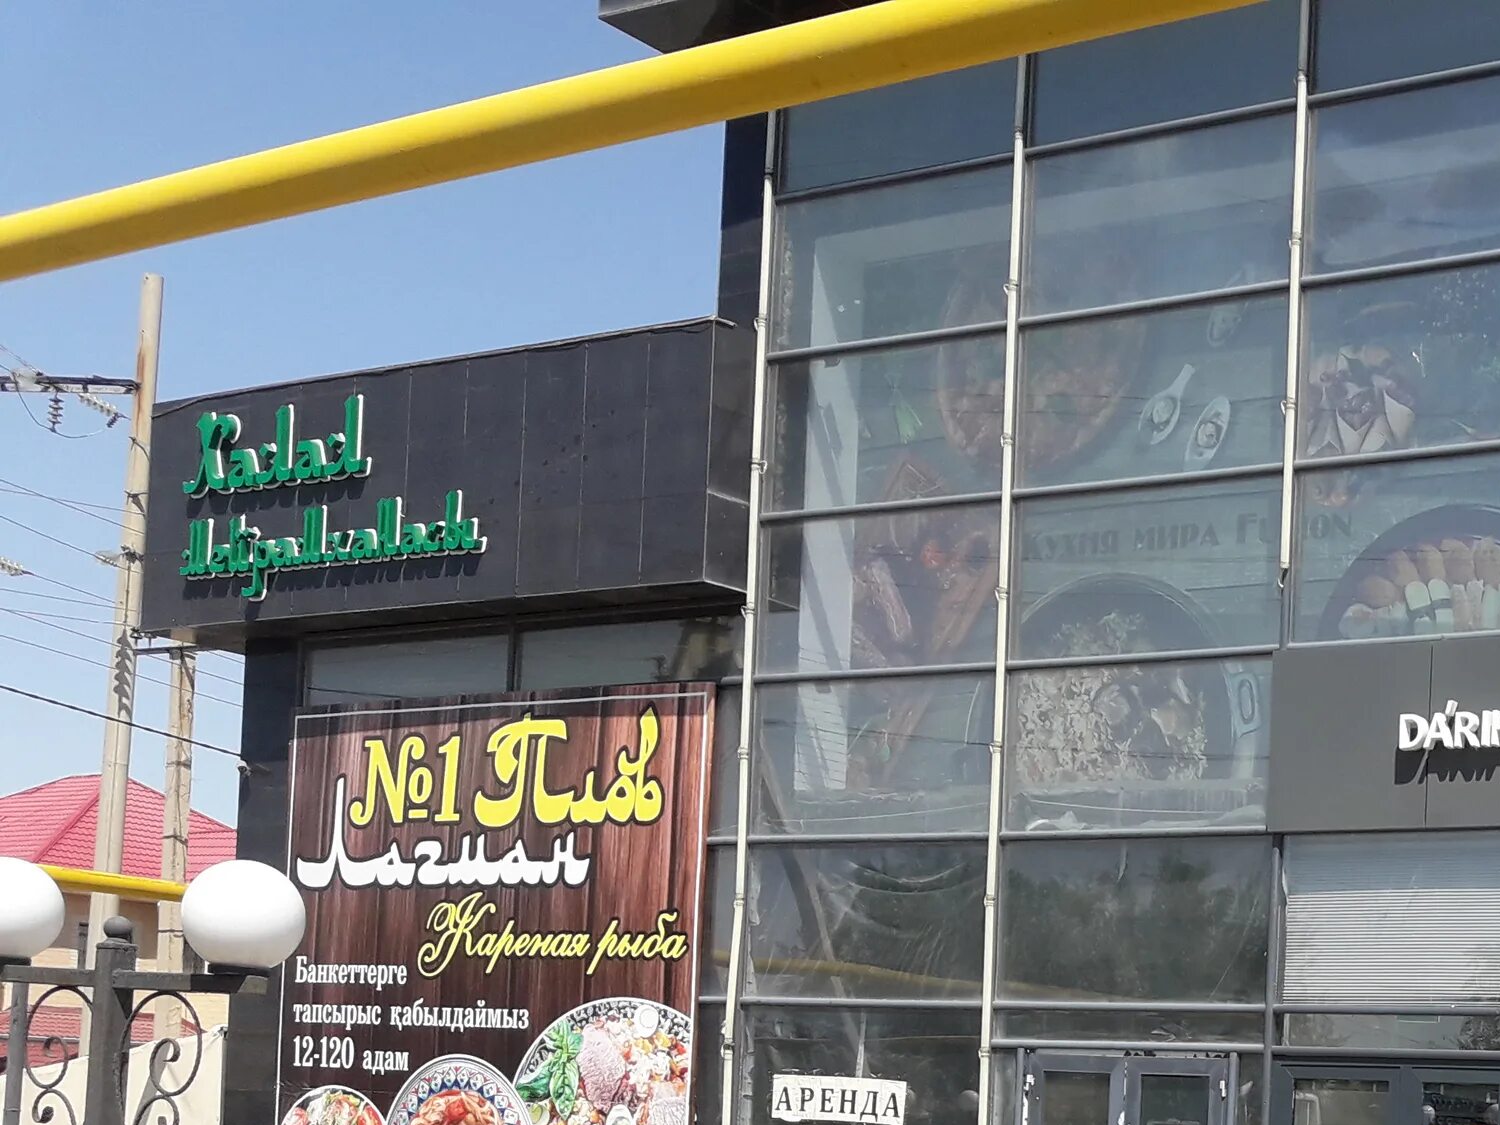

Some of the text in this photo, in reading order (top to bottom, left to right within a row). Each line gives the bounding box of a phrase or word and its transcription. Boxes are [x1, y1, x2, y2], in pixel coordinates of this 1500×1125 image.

[473, 706, 661, 827] Плов
[297, 777, 590, 887] Лагман
[587, 911, 688, 976] рыба
[295, 955, 407, 990] Банкеттерге
[293, 998, 529, 1031] тапсырыс қабылдаймыз
[293, 1035, 409, 1076] 12-120 адам
[775, 1085, 901, 1121] АРЕНДА
